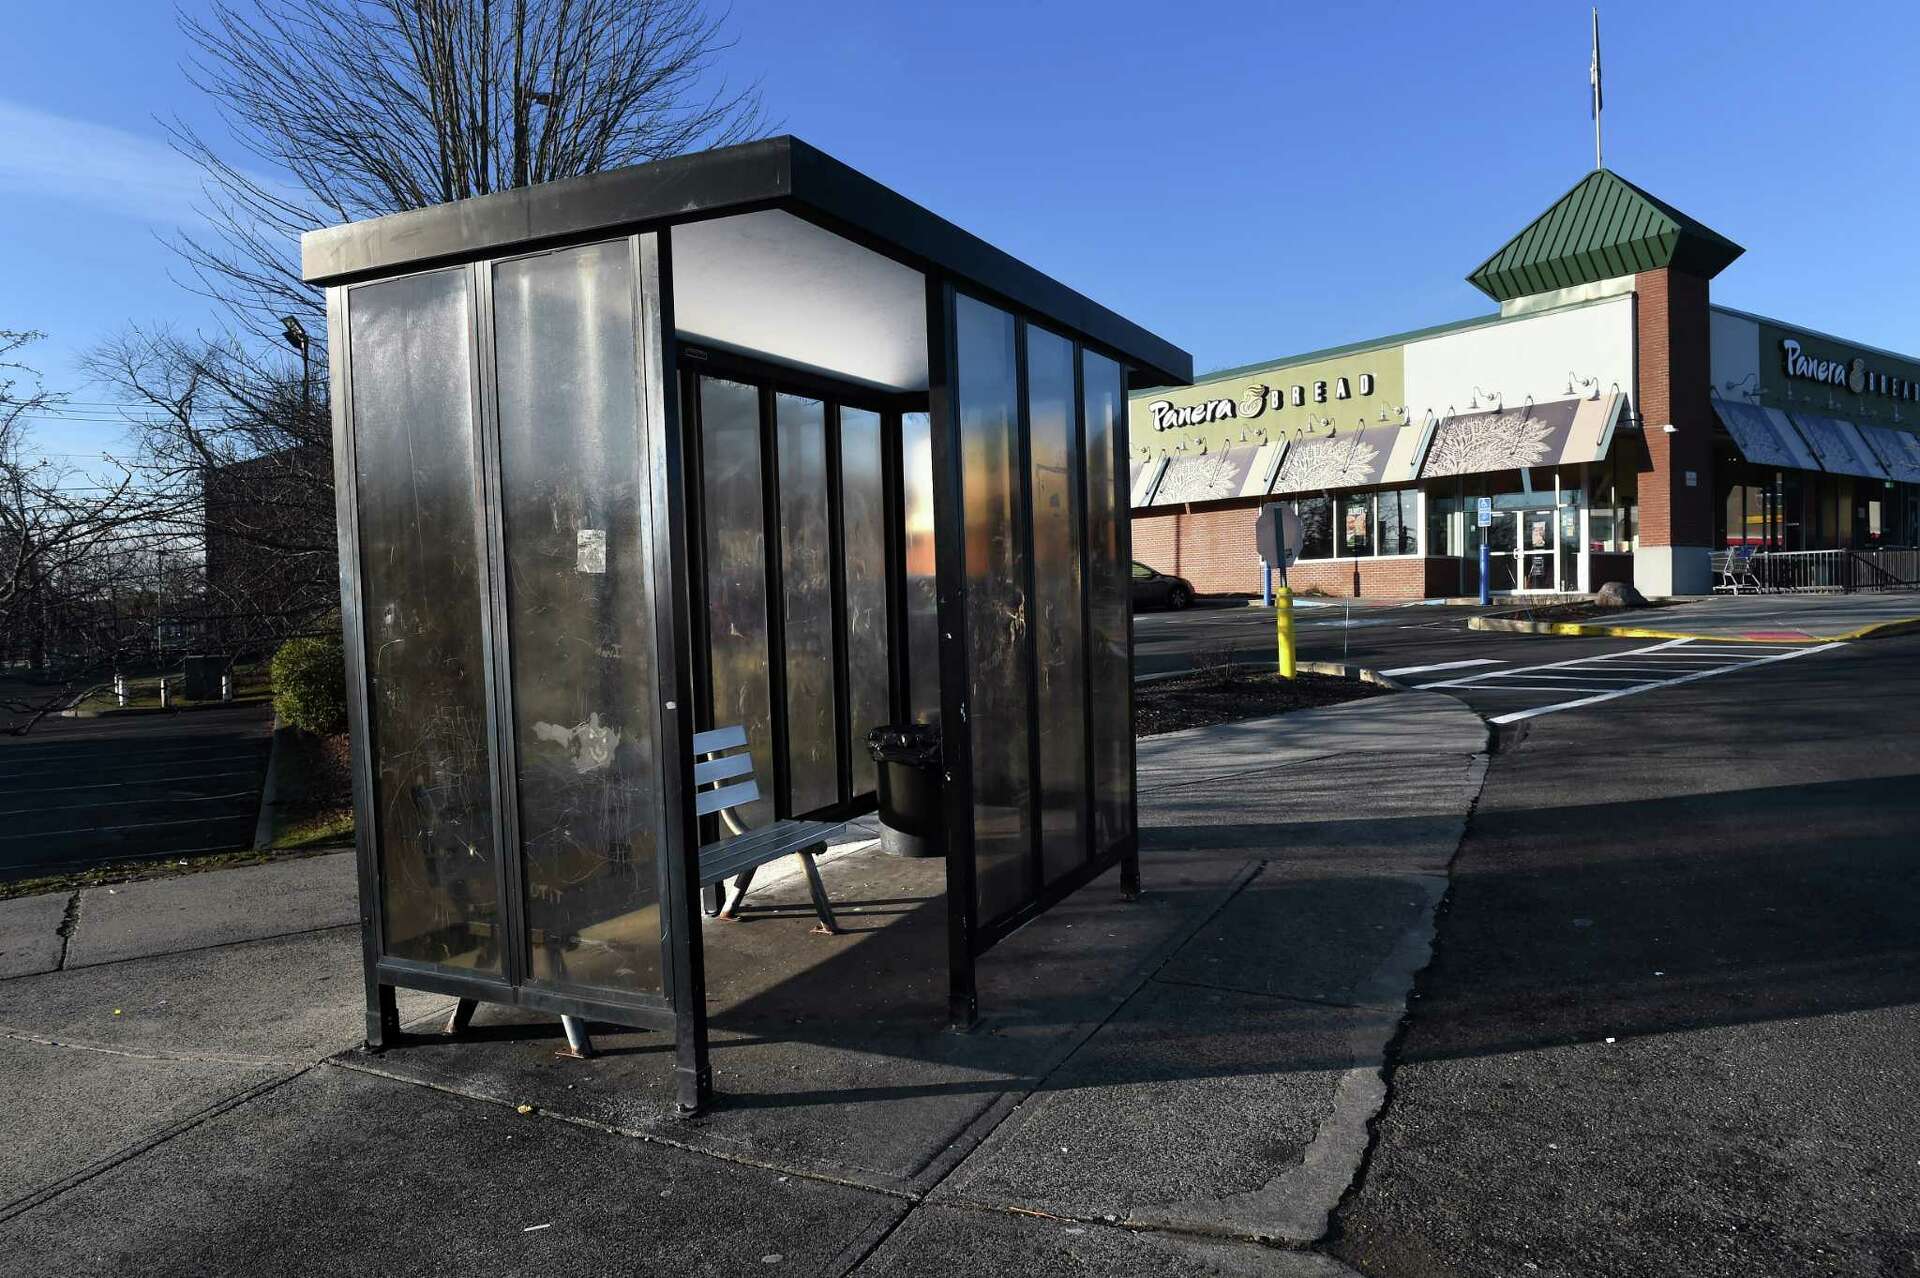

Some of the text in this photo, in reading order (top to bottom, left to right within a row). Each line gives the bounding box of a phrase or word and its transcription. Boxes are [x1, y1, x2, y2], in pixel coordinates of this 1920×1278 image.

[1783, 339, 1847, 386] Panera
[1150, 374, 1375, 431] Panera BREAD
